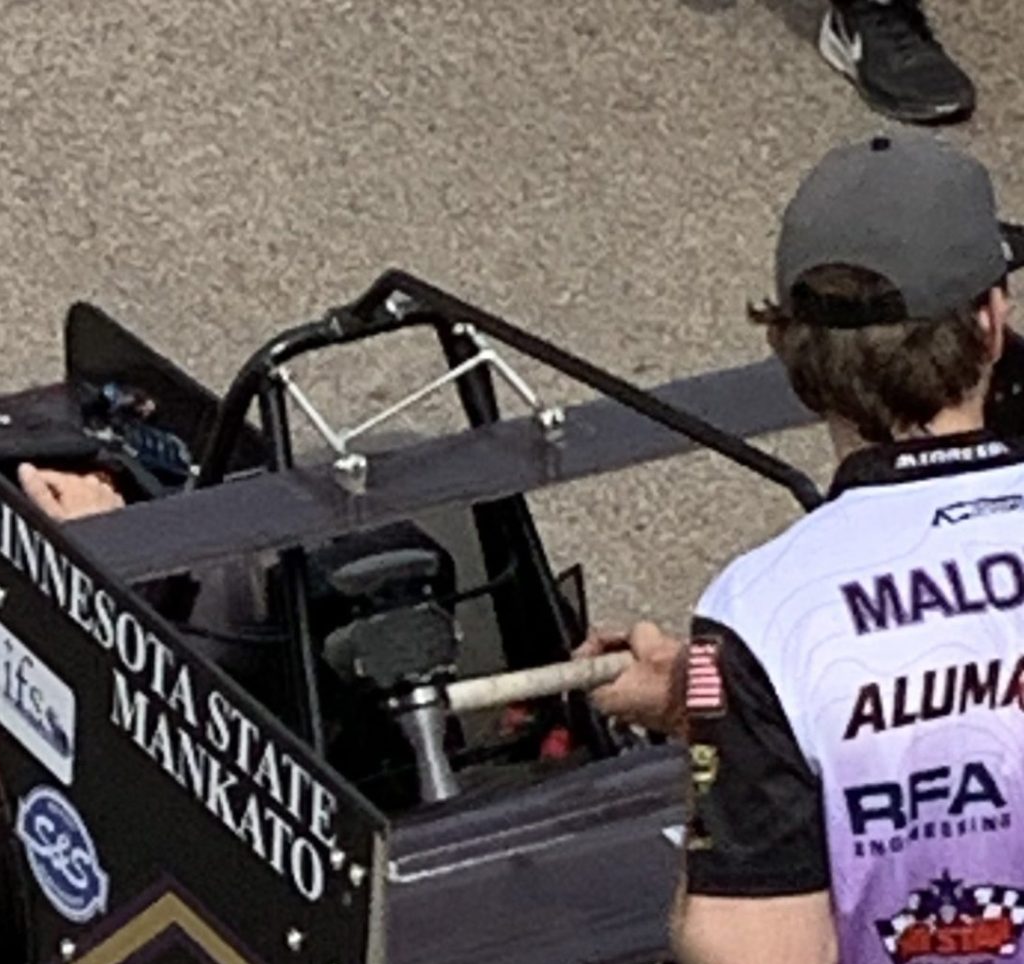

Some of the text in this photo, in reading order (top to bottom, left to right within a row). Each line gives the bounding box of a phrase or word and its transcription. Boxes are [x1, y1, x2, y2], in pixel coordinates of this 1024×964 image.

[110, 668, 324, 900] MANKATO
[207, 691, 338, 849] STATE
[843, 761, 1009, 836] RFA
